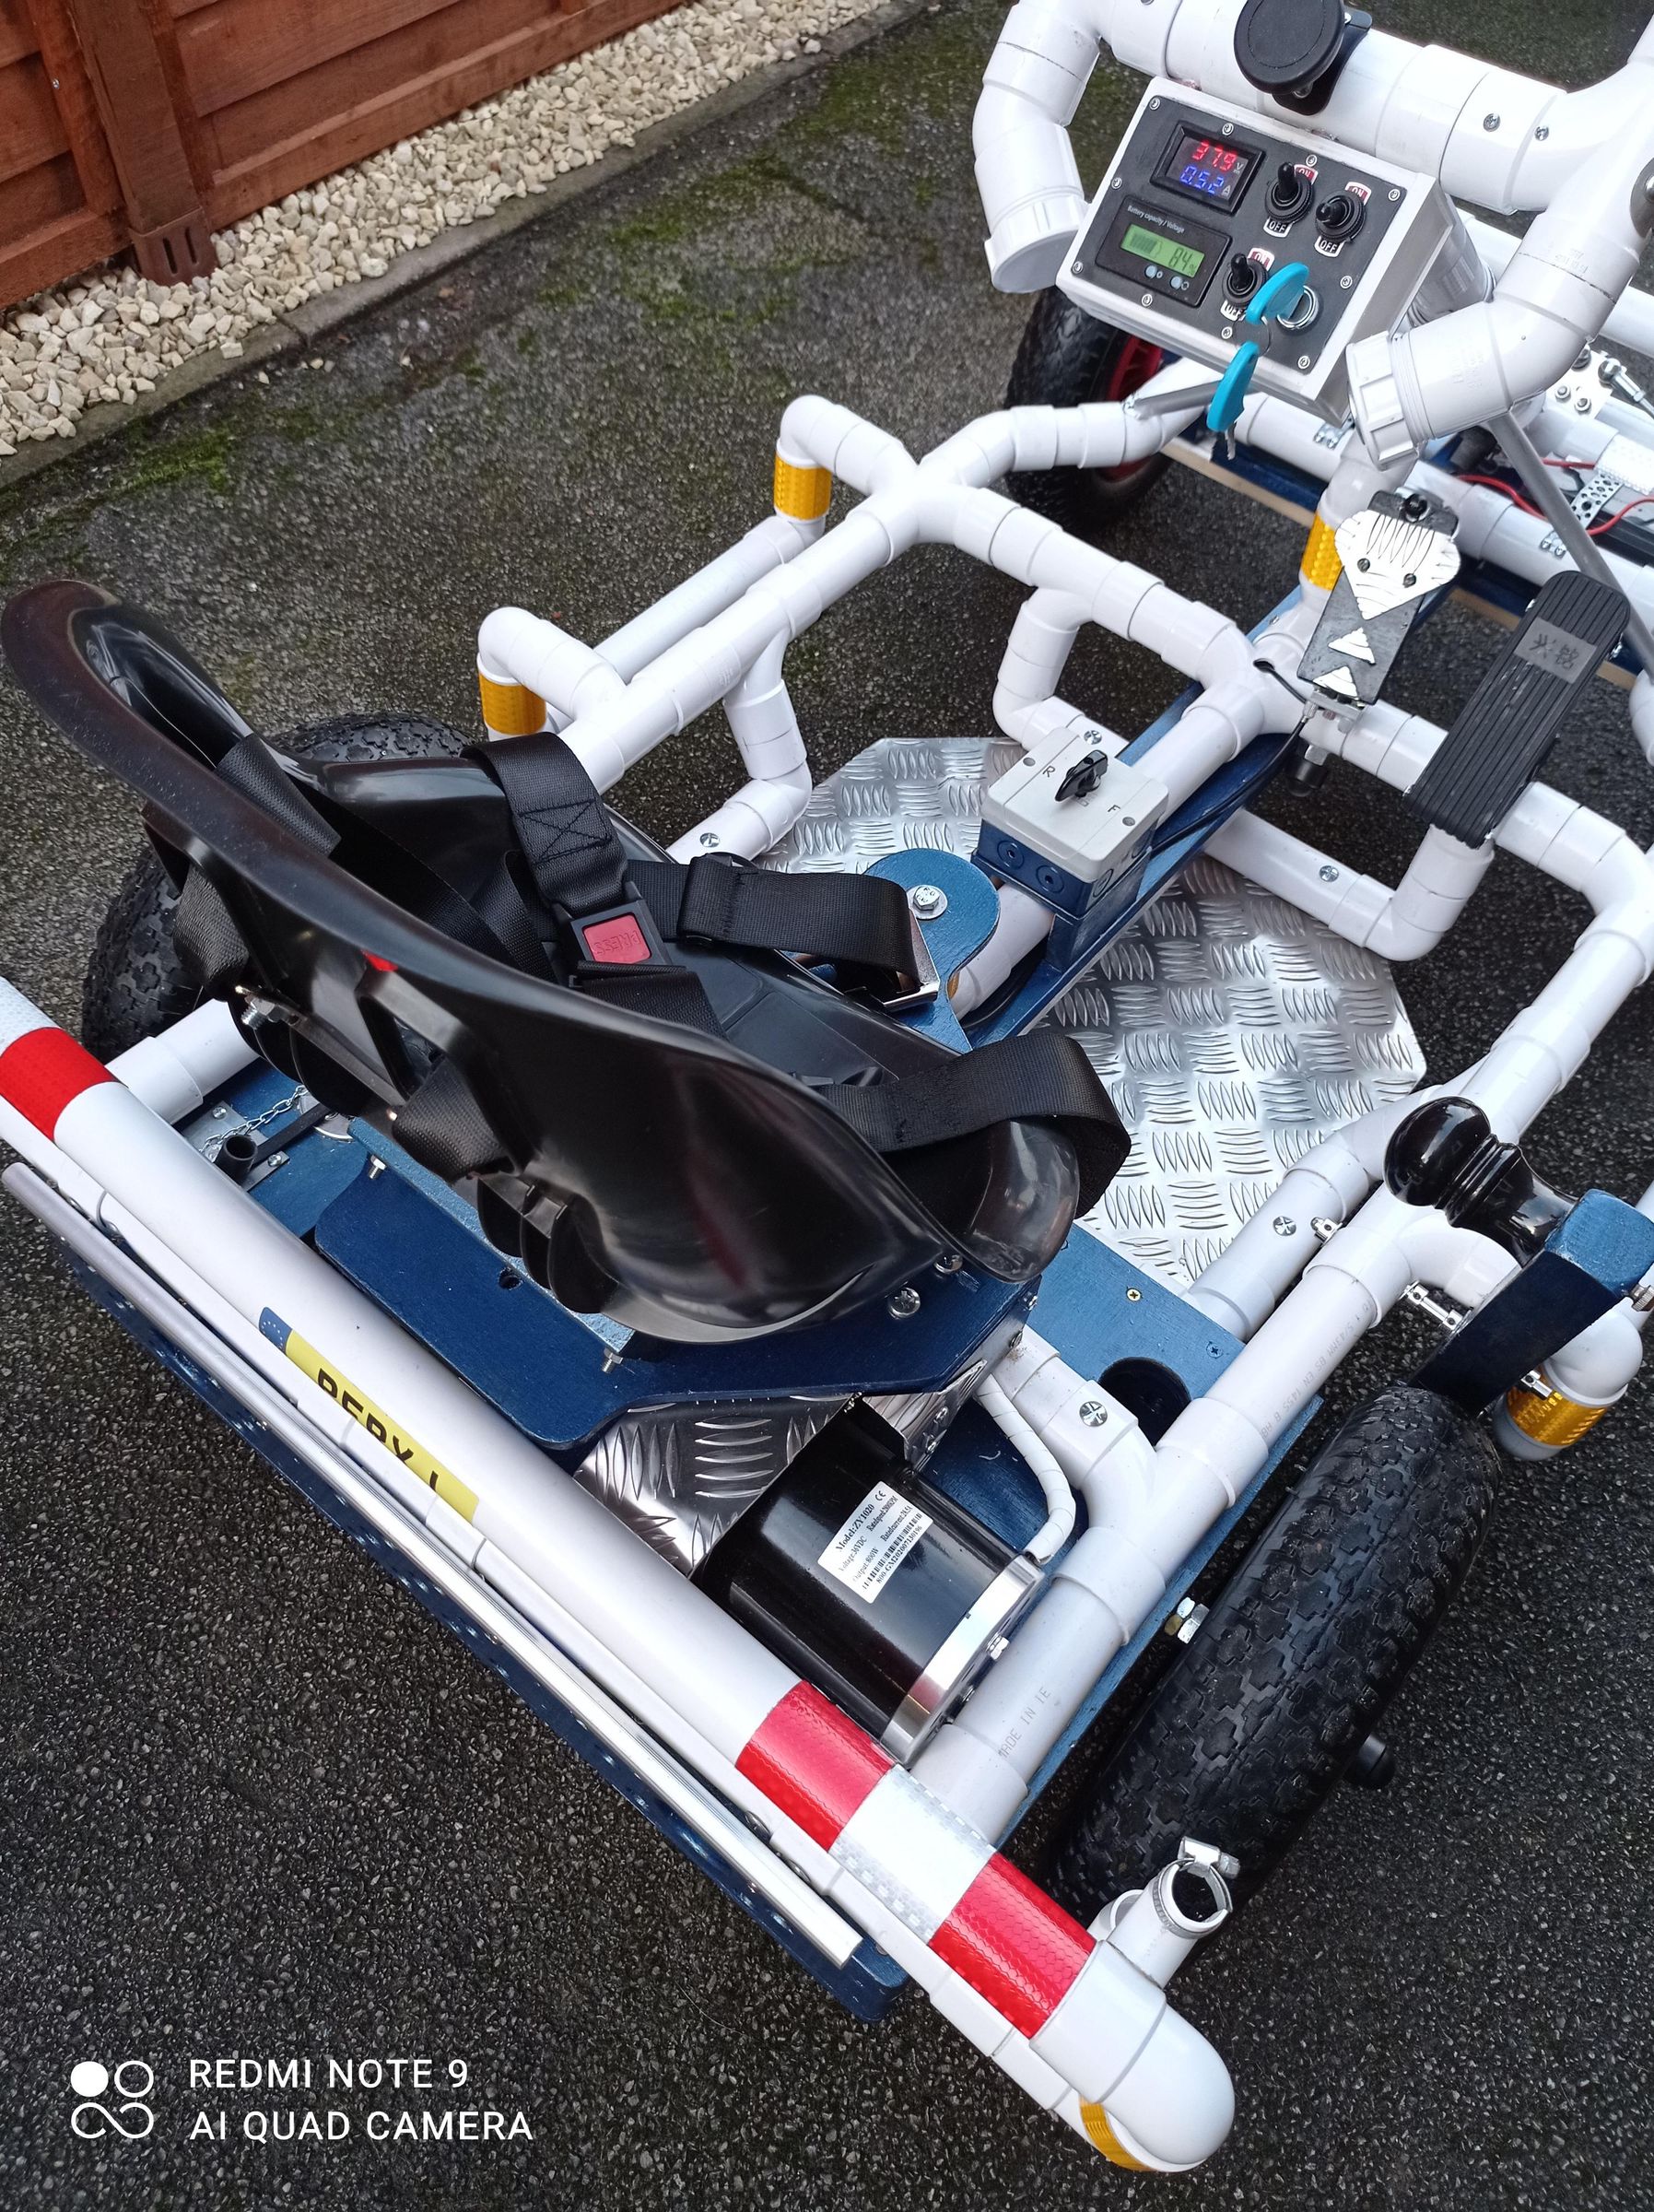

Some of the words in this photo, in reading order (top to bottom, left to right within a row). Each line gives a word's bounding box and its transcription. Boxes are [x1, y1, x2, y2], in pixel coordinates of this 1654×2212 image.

[1127, 205, 1144, 218] Battery
[1167, 220, 1185, 234] Voltage
[1269, 220, 1287, 233] OFF
[1320, 240, 1338, 253] OFF
[1042, 765, 1056, 778] R
[1108, 804, 1121, 813] F
[593, 930, 641, 955] PRESS
[1020, 1706, 1036, 1725] IN
